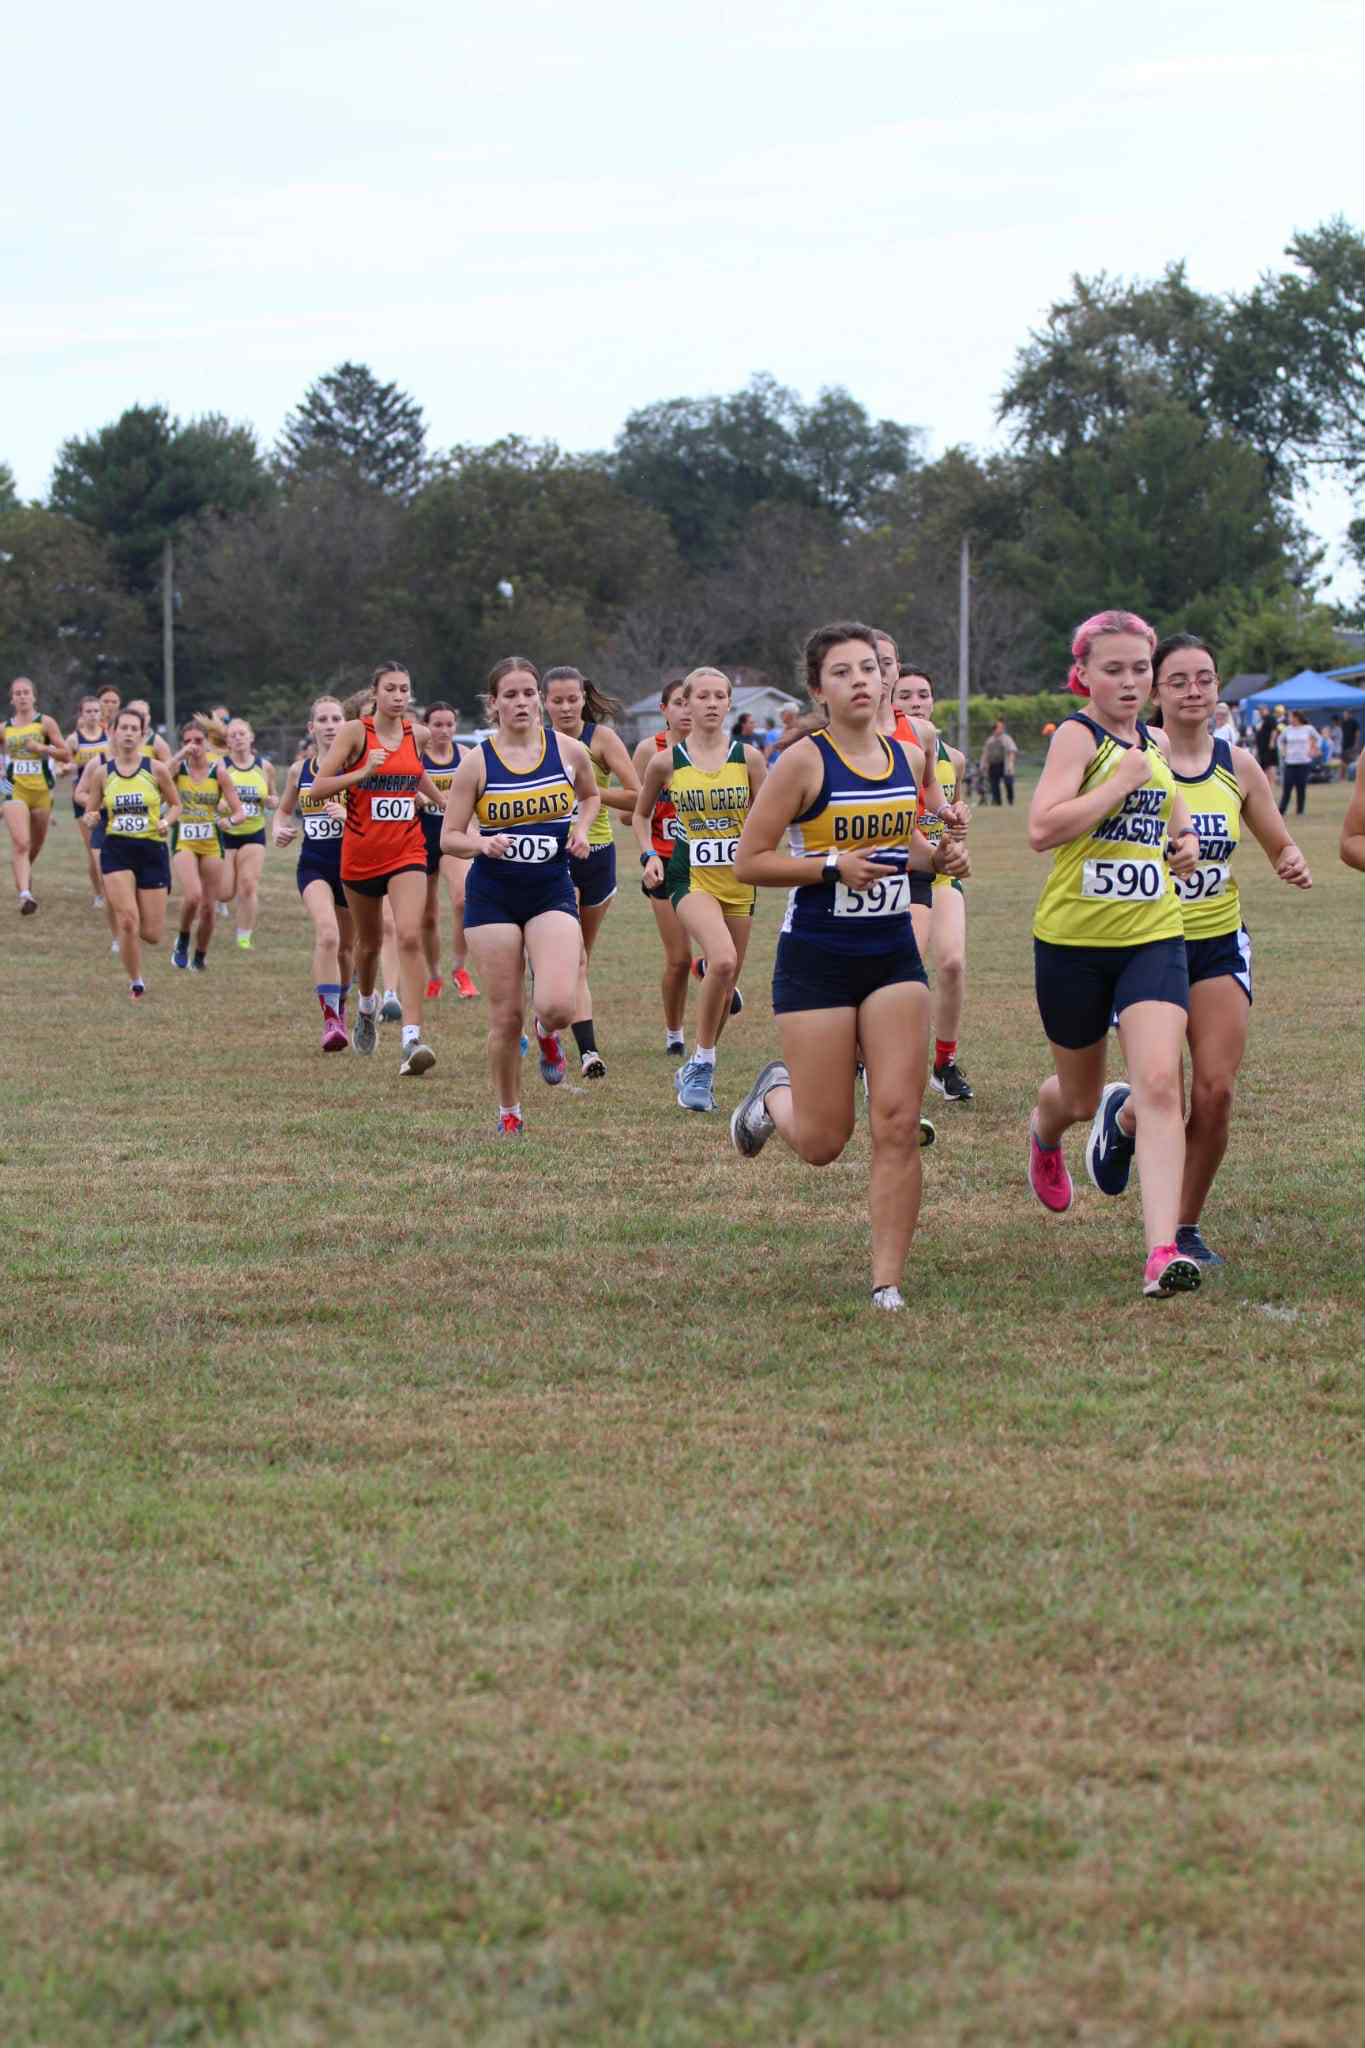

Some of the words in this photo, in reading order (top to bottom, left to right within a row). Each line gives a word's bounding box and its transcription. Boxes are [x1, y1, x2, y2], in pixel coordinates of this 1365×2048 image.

[16, 762, 40, 773] 615
[116, 793, 143, 807] ERIE
[376, 799, 411, 819] 607
[487, 792, 569, 821] BOBCATS
[117, 817, 145, 832] 589
[183, 824, 211, 838] 617
[309, 819, 343, 838] 599
[834, 810, 917, 841] BOBCAT
[1092, 816, 1165, 846] MASON
[1190, 814, 1228, 837] RIE
[503, 836, 550, 861] 605
[1093, 862, 1160, 897] 590
[846, 879, 904, 914] 597
